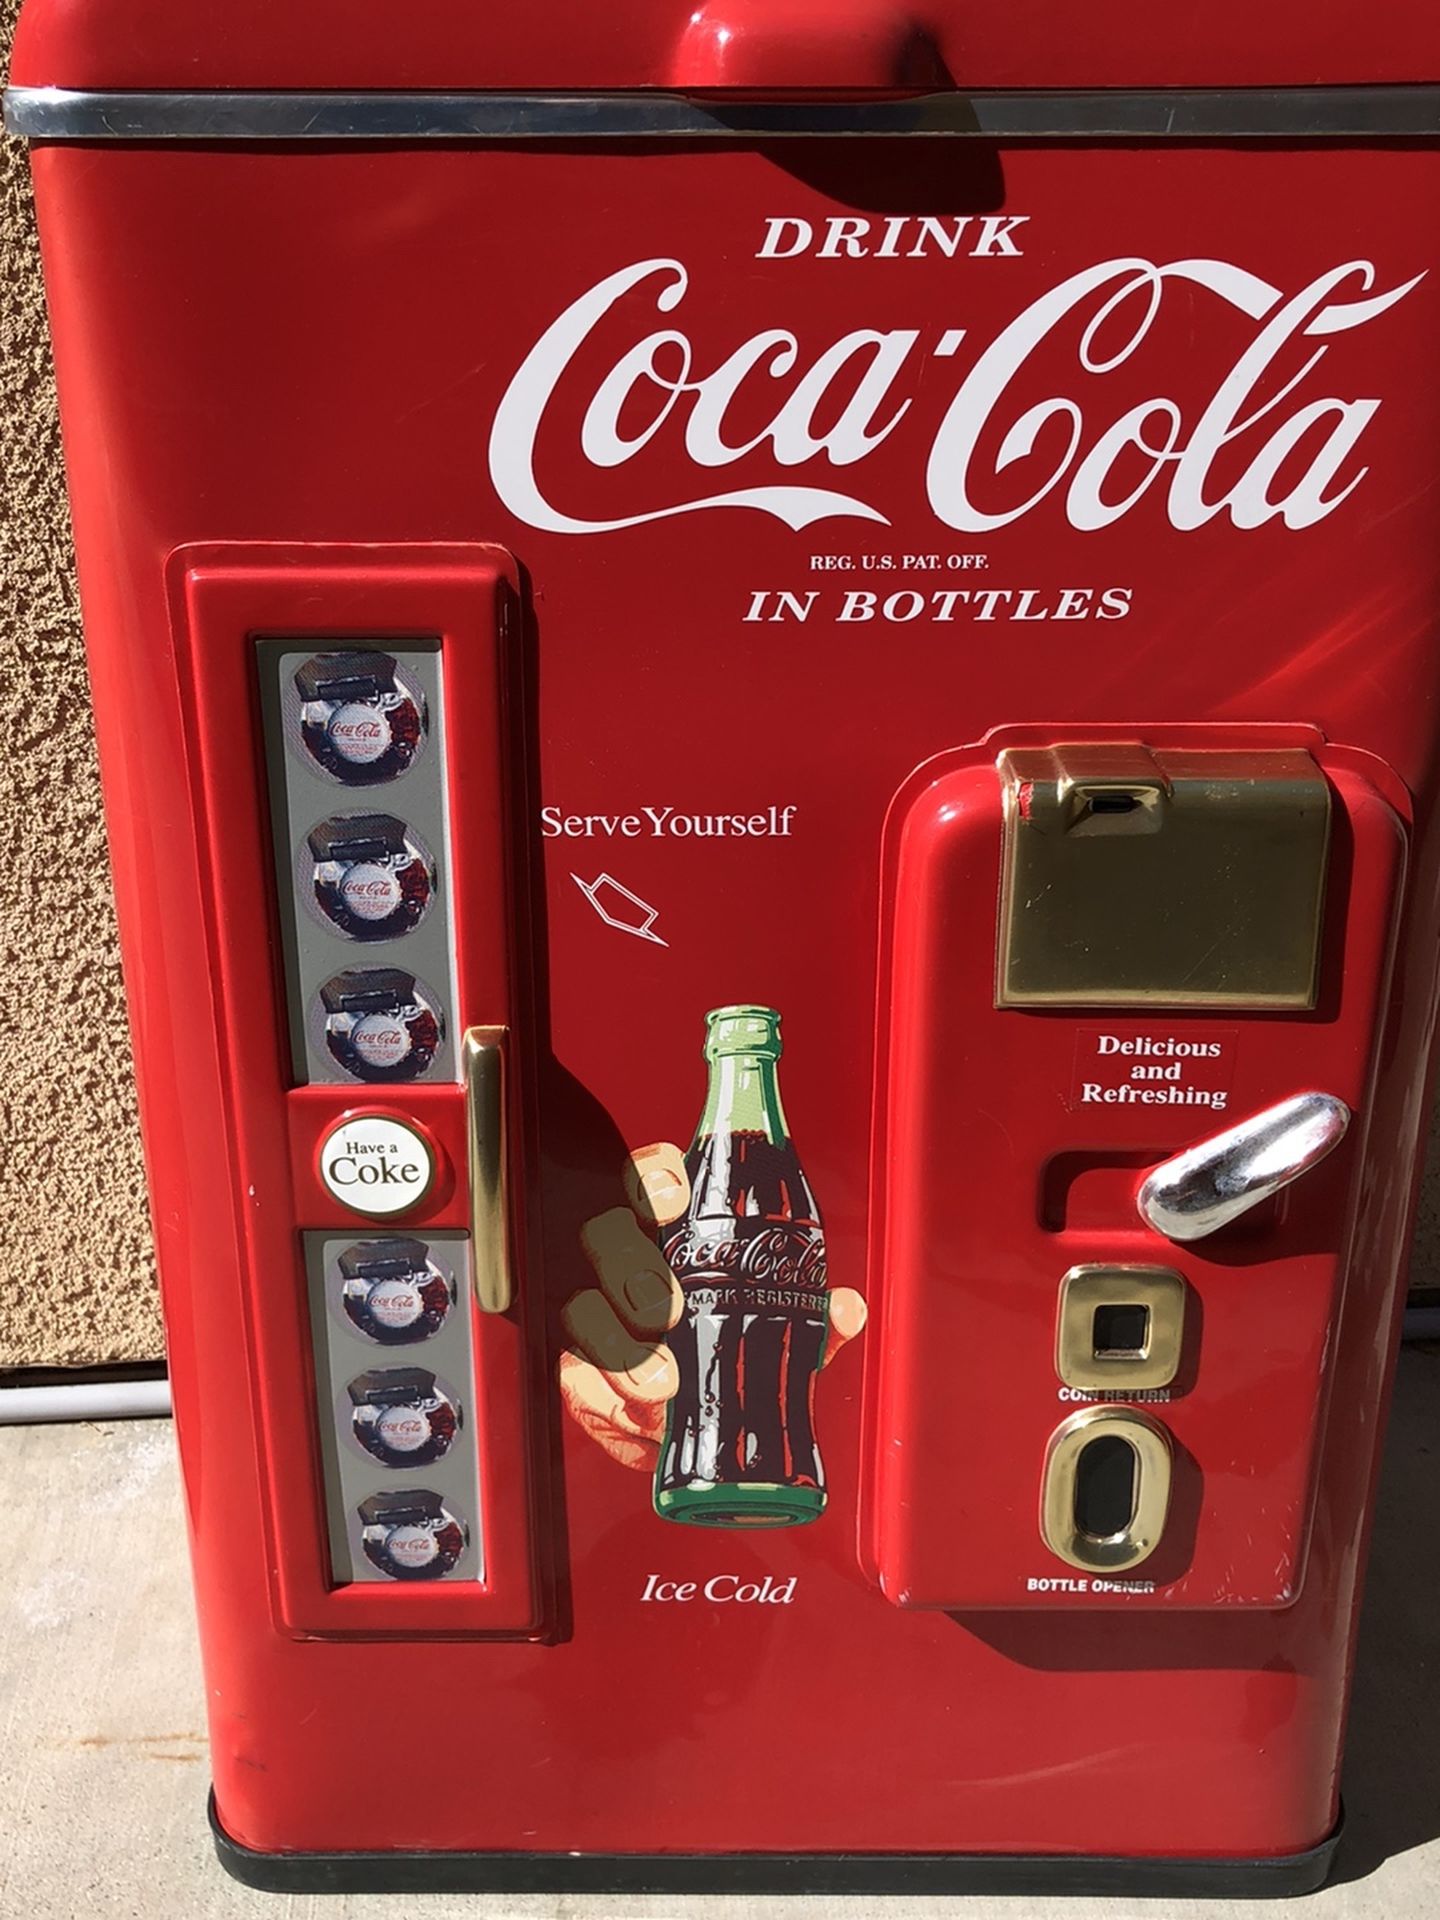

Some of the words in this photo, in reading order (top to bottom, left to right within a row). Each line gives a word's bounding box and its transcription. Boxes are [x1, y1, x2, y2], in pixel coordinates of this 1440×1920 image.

[755, 216, 1031, 258] DRINK
[489, 257, 1429, 534] Coca-Cola
[810, 555, 857, 570] REG.
[862, 555, 898, 570] U.S.
[903, 555, 943, 570] PAT.
[947, 555, 989, 570] OFF.
[743, 591, 821, 622] IN
[836, 587, 1133, 622] BOTTLES
[541, 806, 643, 837] Serve
[641, 805, 798, 837] Yourself
[1097, 1035, 1222, 1057] Delicious
[1130, 1062, 1182, 1080] and
[1081, 1083, 1228, 1110] Refreshing
[346, 1142, 385, 1154] Have
[389, 1144, 398, 1153] a
[329, 1156, 420, 1185] Coke
[1058, 1387, 1099, 1402] COIN
[1104, 1389, 1171, 1403] RETURN
[640, 1574, 697, 1602] Ice
[704, 1575, 798, 1604] Cold
[1027, 1578, 1088, 1592] BOTTLE
[1091, 1579, 1155, 1594] OPENER
